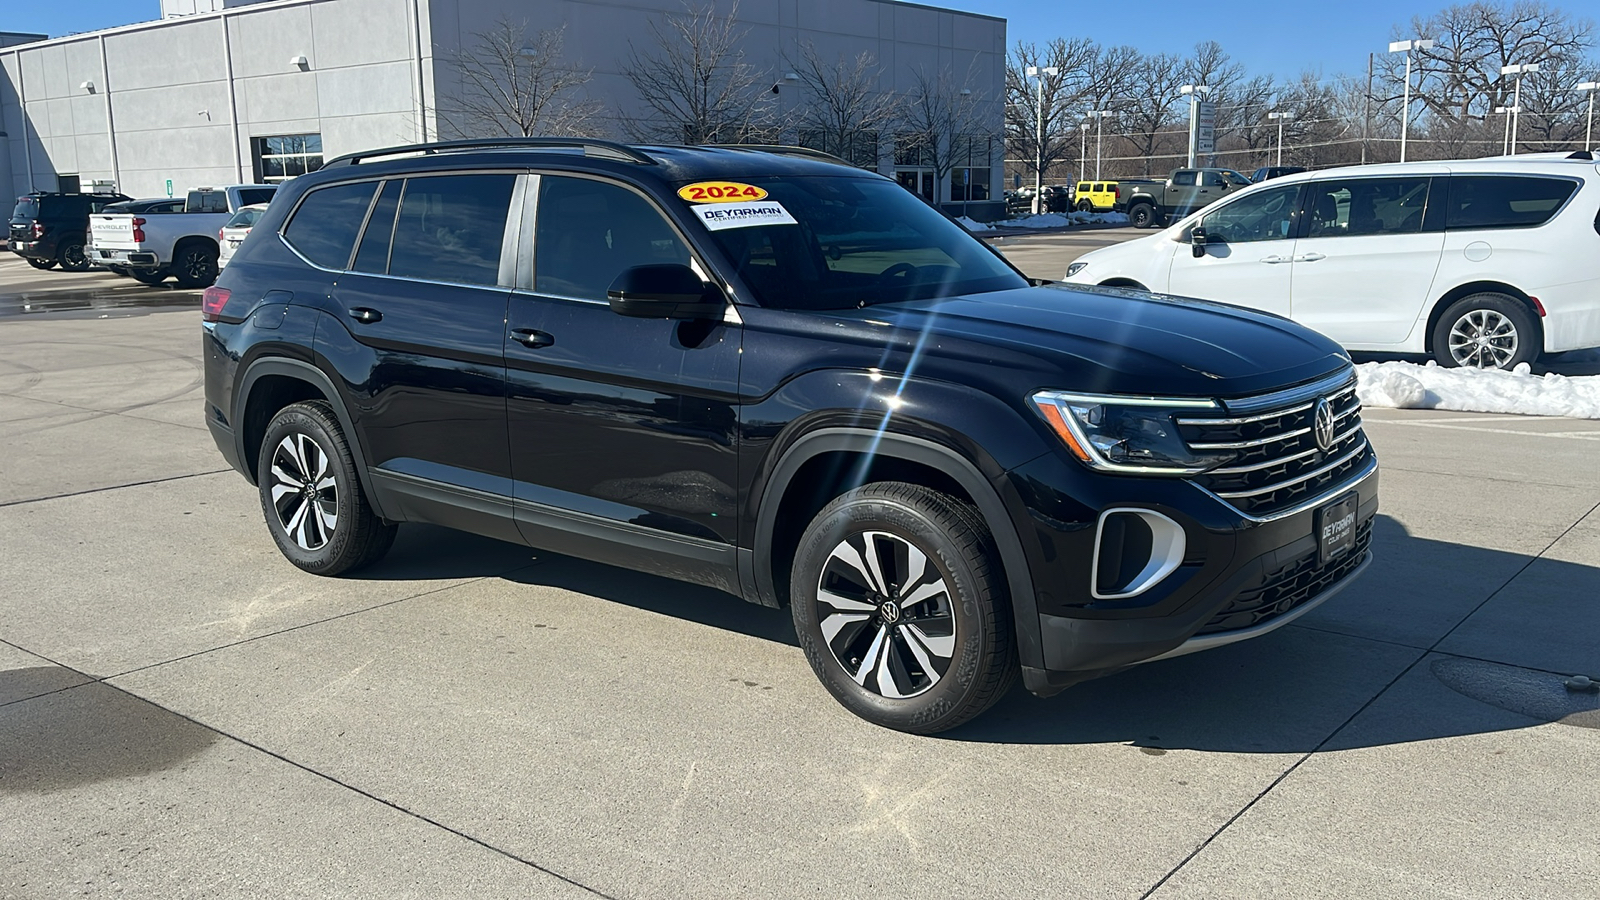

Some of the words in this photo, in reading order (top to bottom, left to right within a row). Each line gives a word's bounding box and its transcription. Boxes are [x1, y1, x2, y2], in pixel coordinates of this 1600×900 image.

[689, 186, 760, 200] 2024
[704, 207, 782, 219] DEYARMAN
[1323, 511, 1355, 540] DEYARMAN
[936, 547, 975, 617] KUMHO
